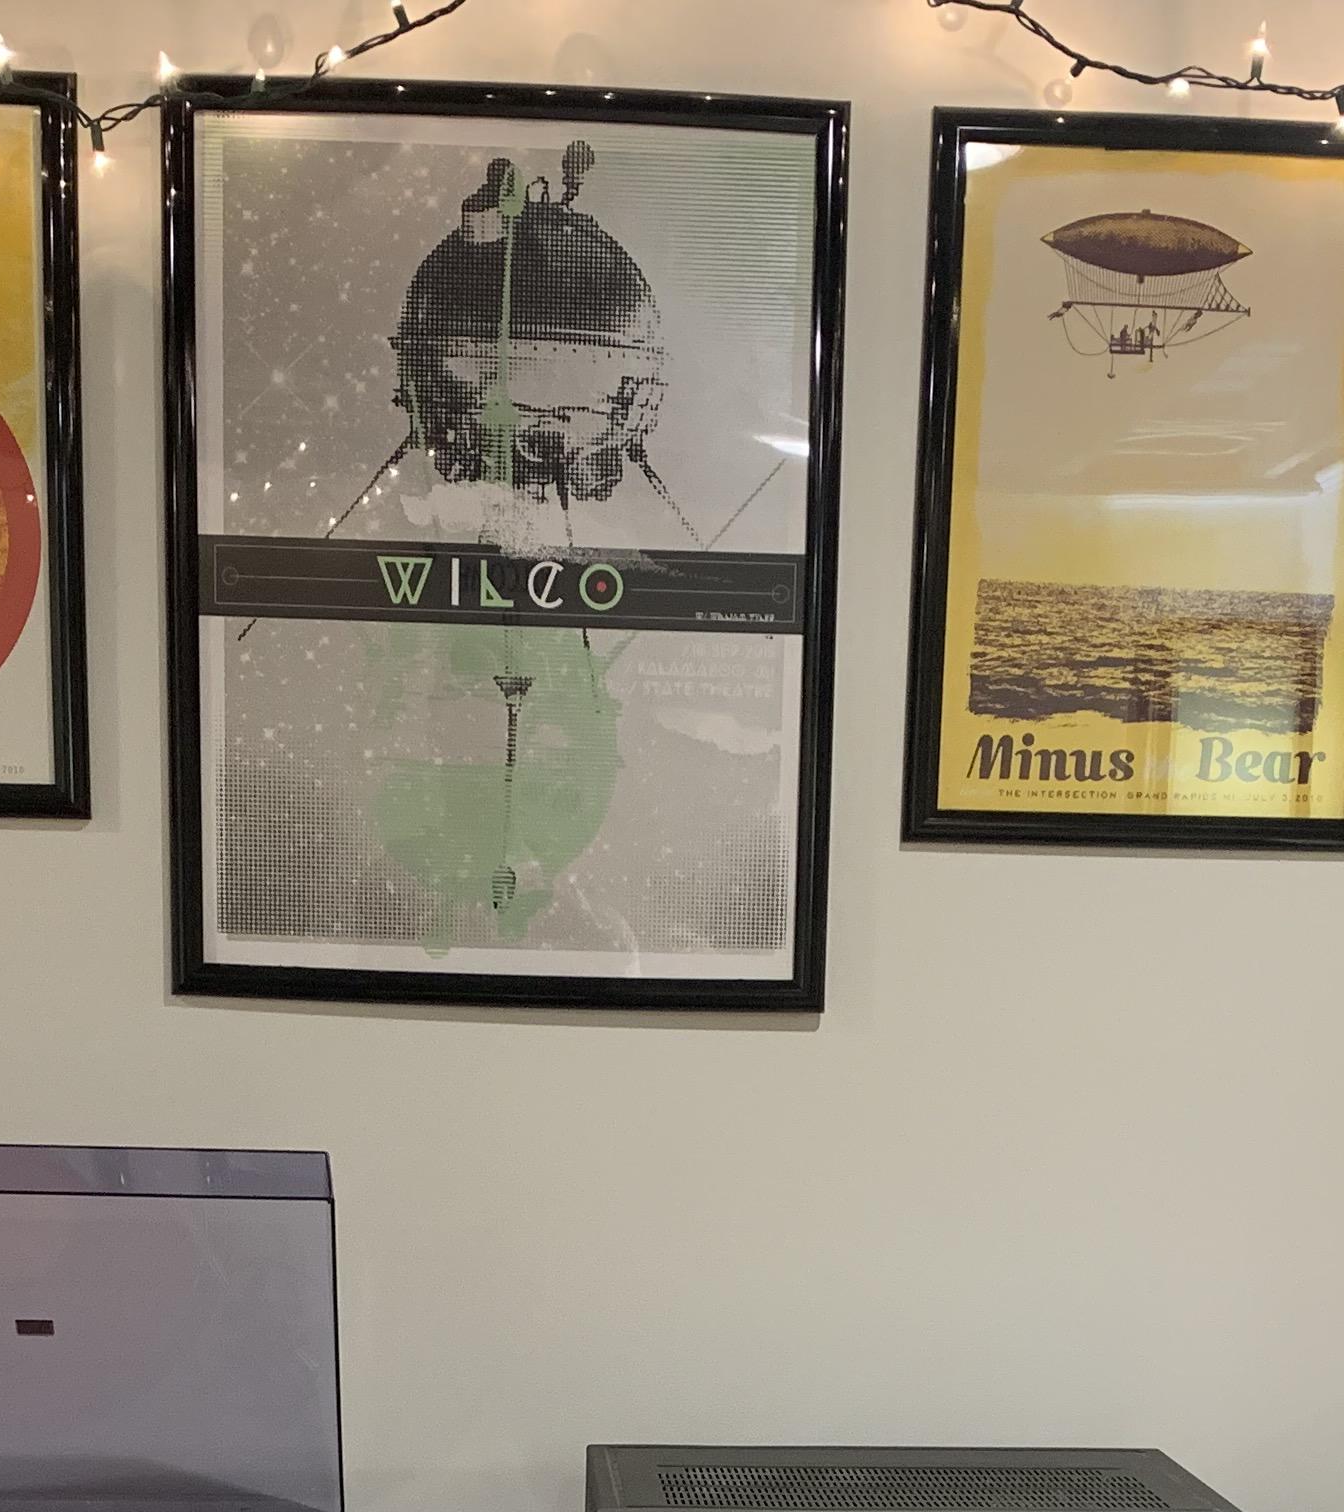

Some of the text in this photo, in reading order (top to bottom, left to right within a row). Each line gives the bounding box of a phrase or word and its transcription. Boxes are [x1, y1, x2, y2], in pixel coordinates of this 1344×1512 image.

[376, 554, 625, 611] WILCO
[966, 732, 1136, 782] Minus
[1196, 736, 1327, 785] Bear
[998, 788, 1022, 798] THE
[1127, 791, 1169, 801] GRAND
[1173, 791, 1218, 801] RAPIDS
